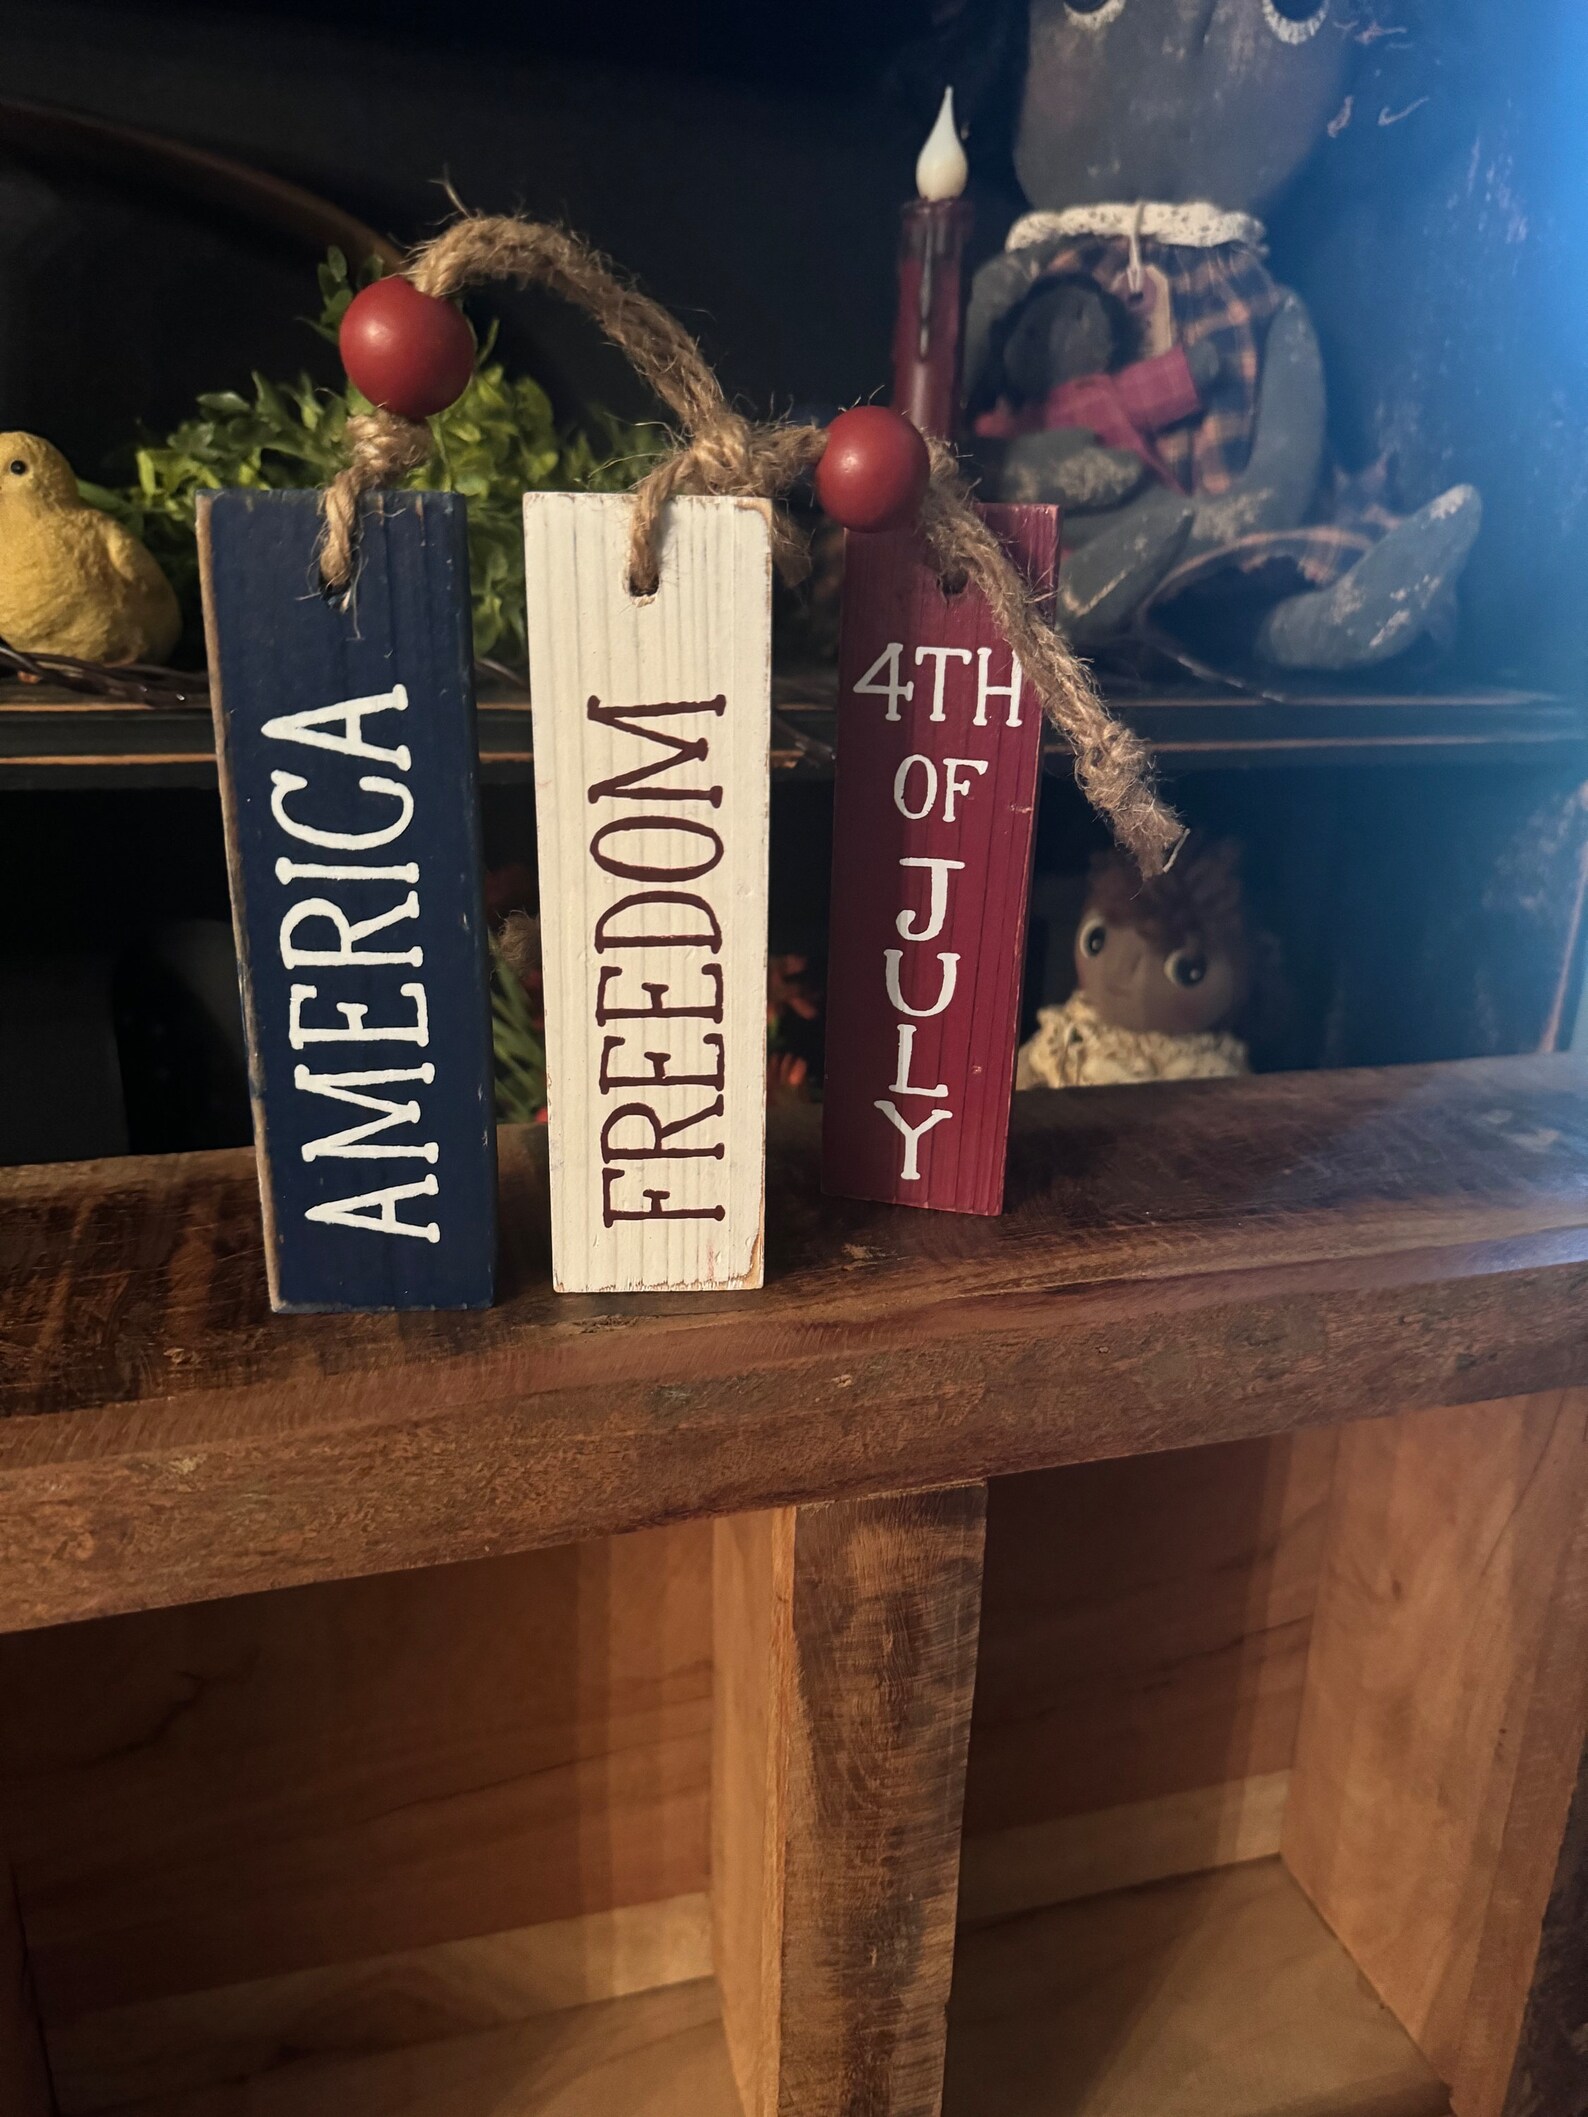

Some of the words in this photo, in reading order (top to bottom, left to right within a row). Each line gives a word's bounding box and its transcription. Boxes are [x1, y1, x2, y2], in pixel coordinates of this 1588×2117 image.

[853, 642, 1023, 728] 4TH
[893, 753, 989, 823] OF
[260, 682, 441, 1244] AMERICA
[586, 693, 727, 1228] FREEDOM
[873, 856, 966, 1180] JULY
